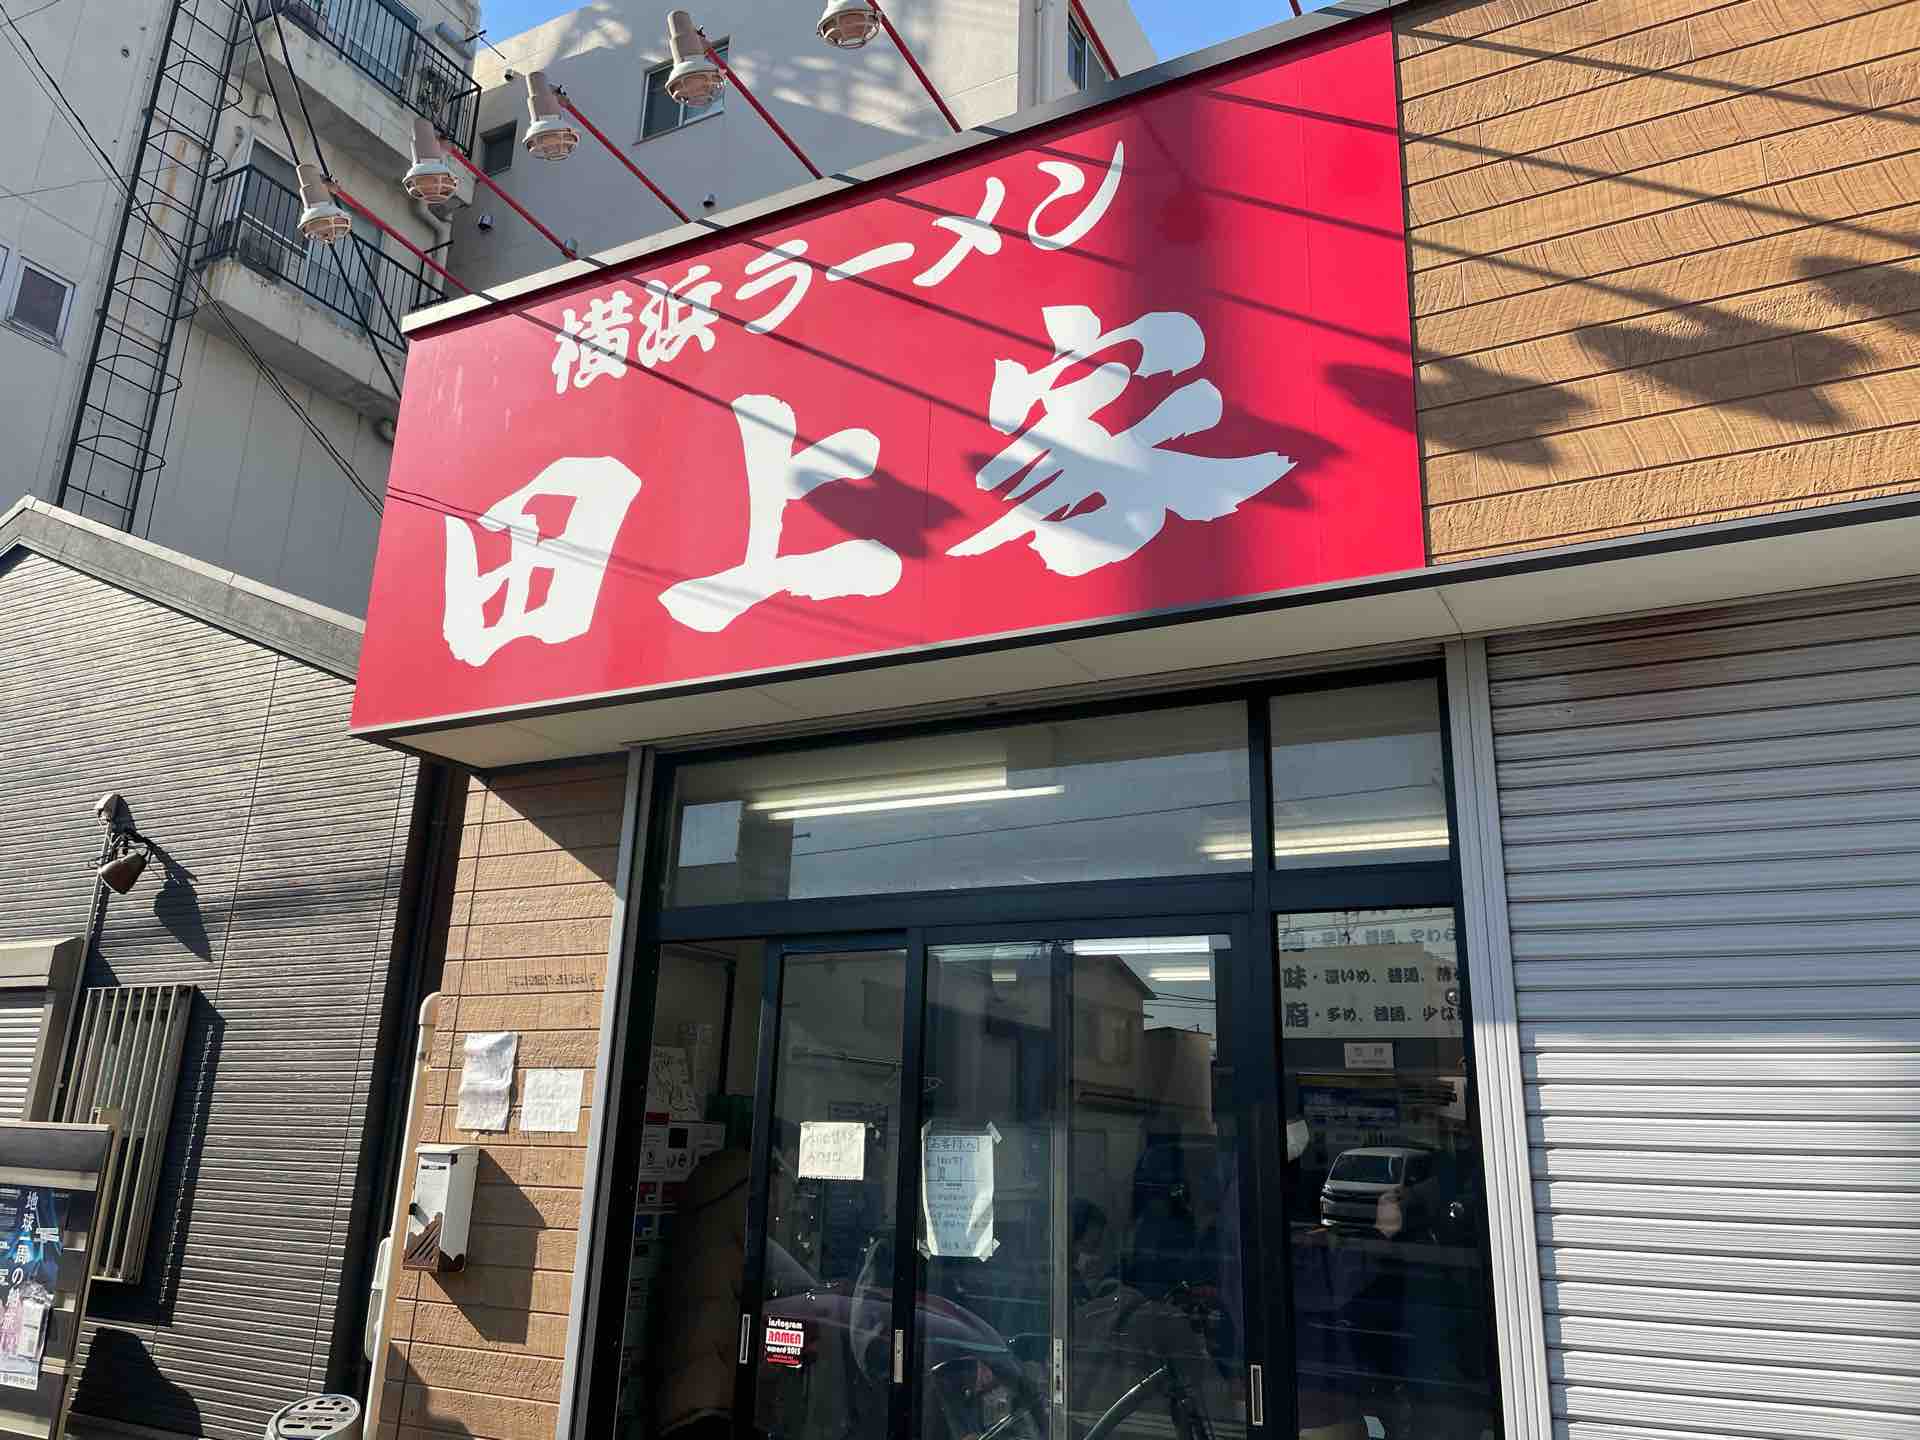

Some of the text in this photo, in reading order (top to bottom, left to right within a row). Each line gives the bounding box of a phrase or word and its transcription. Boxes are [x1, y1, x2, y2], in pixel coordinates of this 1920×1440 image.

[552, 141, 1124, 394] 横浜ラーメン
[442, 305, 1299, 669] 田上家
[768, 1331, 801, 1345] RAMEN
